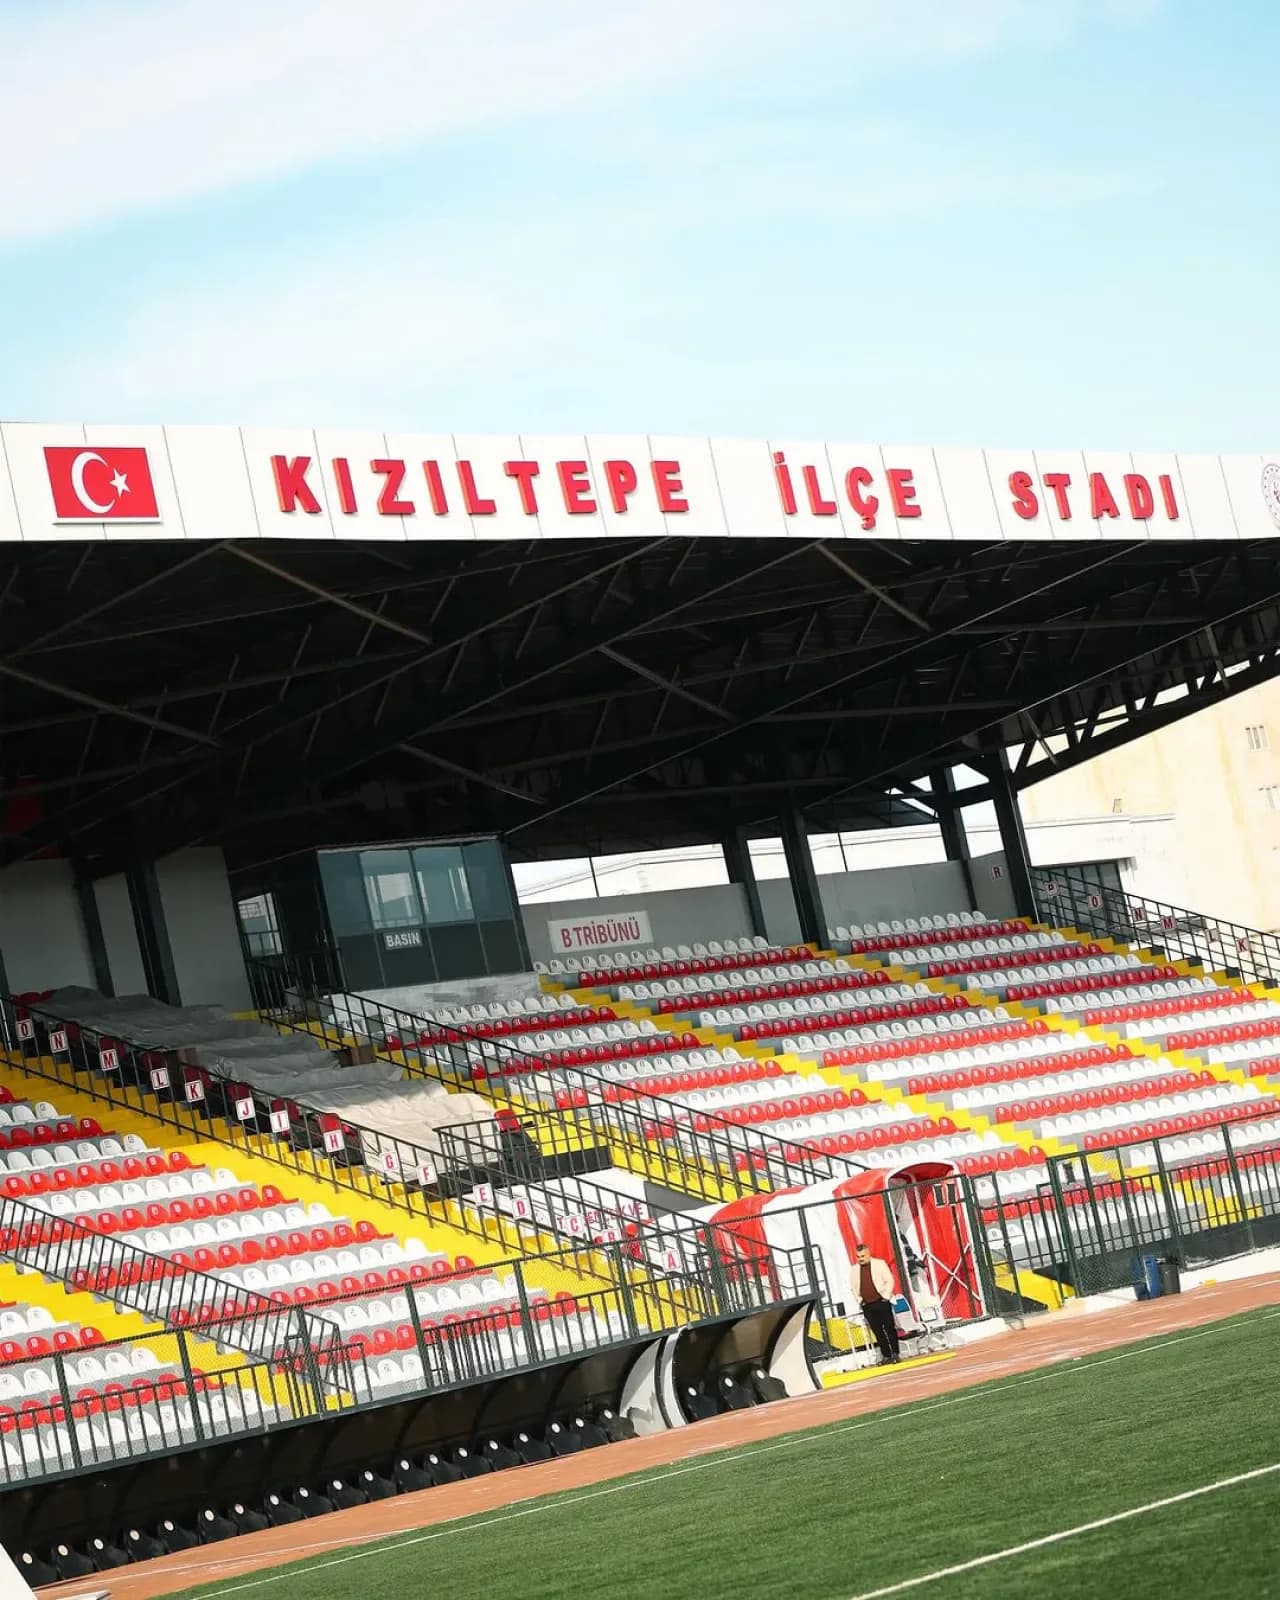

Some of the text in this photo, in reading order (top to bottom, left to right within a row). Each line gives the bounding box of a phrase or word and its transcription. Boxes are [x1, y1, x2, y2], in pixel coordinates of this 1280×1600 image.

[271, 451, 1179, 530] KIZILTEPE İLÇE STADI
[993, 866, 1002, 878] R
[1162, 917, 1173, 929] M
[561, 916, 640, 947] B TRİBÜNÜ
[385, 932, 421, 947] BASIN
[1238, 938, 1247, 952] K
[54, 1034, 64, 1049] N
[103, 1053, 115, 1068] M
[155, 1071, 164, 1086] L
[190, 1083, 199, 1099] K
[242, 1102, 250, 1116] J
[329, 1135, 339, 1149] H
[422, 1167, 430, 1181] F
[479, 1187, 487, 1202] E
[570, 1217, 579, 1232] C
[667, 1253, 676, 1269] A
